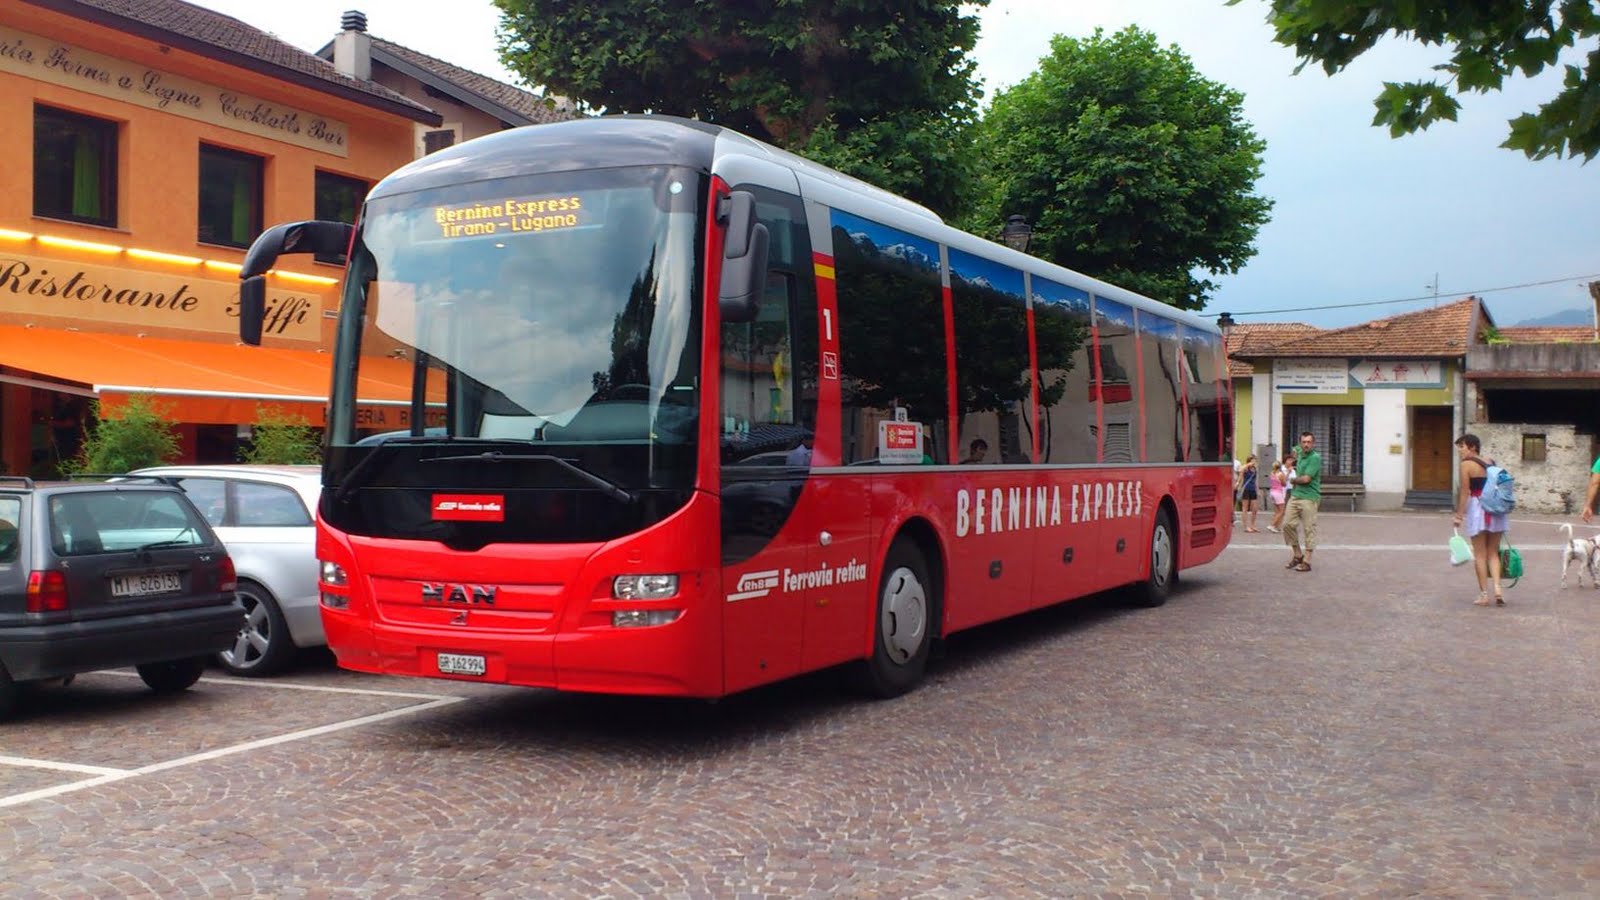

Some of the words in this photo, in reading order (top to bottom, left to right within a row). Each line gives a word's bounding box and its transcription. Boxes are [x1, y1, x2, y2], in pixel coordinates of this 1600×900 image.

[44, 47, 110, 84] Forno
[118, 74, 133, 89] a
[140, 70, 202, 108] Legna
[219, 92, 300, 135] Cocktails
[308, 119, 345, 147] Bar
[435, 203, 502, 223] Bernina
[505, 197, 582, 217] Express
[441, 222, 496, 238] Tirano
[511, 214, 577, 233] Lugano
[0, 258, 200, 312] Ristorante
[225, 291, 311, 334] iffi
[823, 308, 832, 340] 1
[956, 486, 1061, 538] BERNINA
[1071, 481, 1142, 523] EXPRESS
[744, 579, 765, 592] RhB
[783, 561, 833, 592] Ferrovia
[836, 557, 867, 584] retica
[422, 584, 496, 605] MAN
[451, 657, 485, 671] 162994
